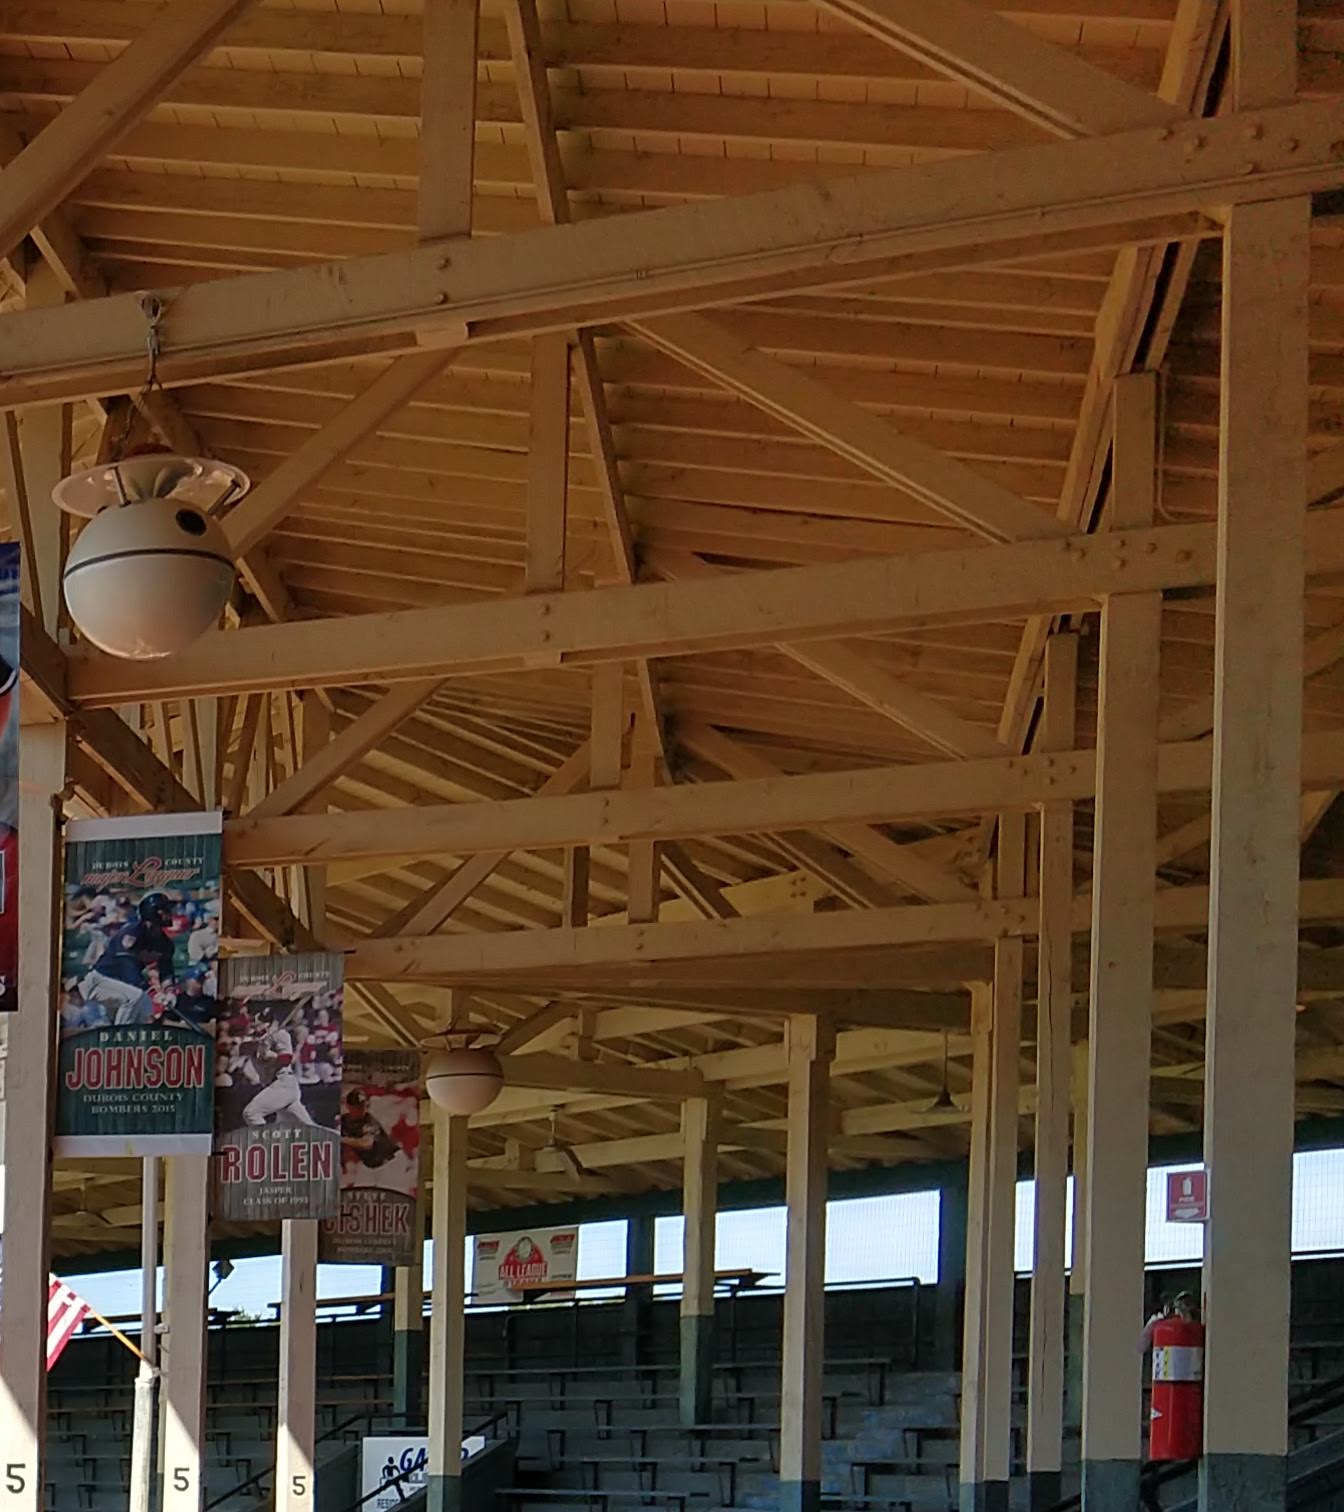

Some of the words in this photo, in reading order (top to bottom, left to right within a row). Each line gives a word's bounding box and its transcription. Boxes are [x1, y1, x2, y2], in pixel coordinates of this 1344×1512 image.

[99, 1030, 173, 1042] DANIEL
[65, 1044, 206, 1090] JOHNSON
[132, 1092, 184, 1102] COUNTY
[91, 1104, 148, 1114] BOMBERS
[252, 1128, 302, 1140] SCOTT
[221, 1141, 333, 1184] ROLEN
[6, 1463, 26, 1494] 5
[174, 1467, 190, 1492] 5
[292, 1475, 306, 1496] 5
